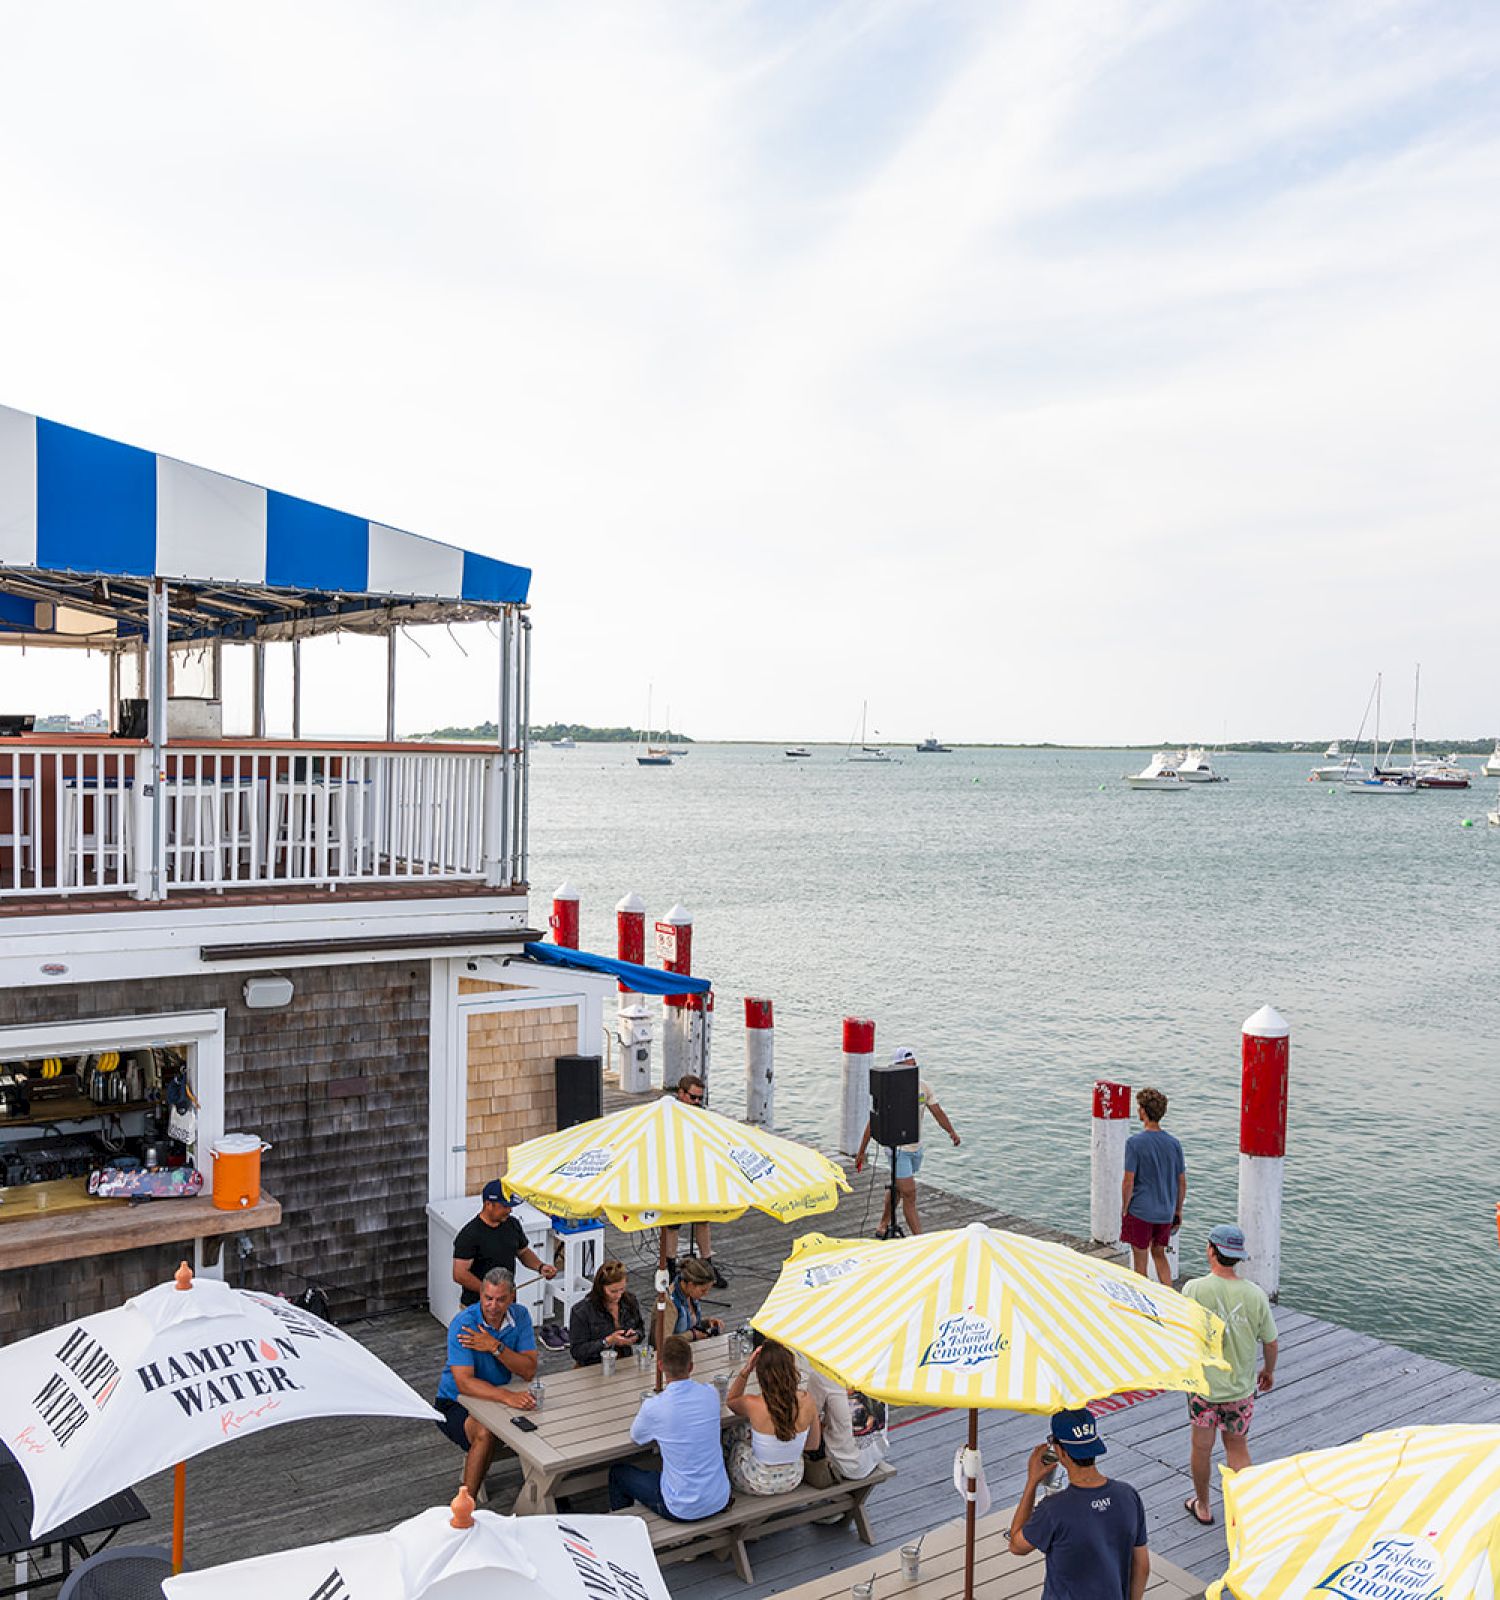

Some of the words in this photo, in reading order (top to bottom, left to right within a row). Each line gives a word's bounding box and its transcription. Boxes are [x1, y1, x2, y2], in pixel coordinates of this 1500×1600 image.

[939, 1316, 985, 1337] Fishers
[949, 1328, 992, 1346] Island
[918, 1333, 1009, 1368] Lemonade
[171, 1365, 301, 1417] WATER
[32, 1372, 91, 1447] WATER
[1366, 1539, 1435, 1570] Fishers
[1314, 1560, 1445, 1600] Lemonad
[1371, 1563, 1435, 1588] Island
